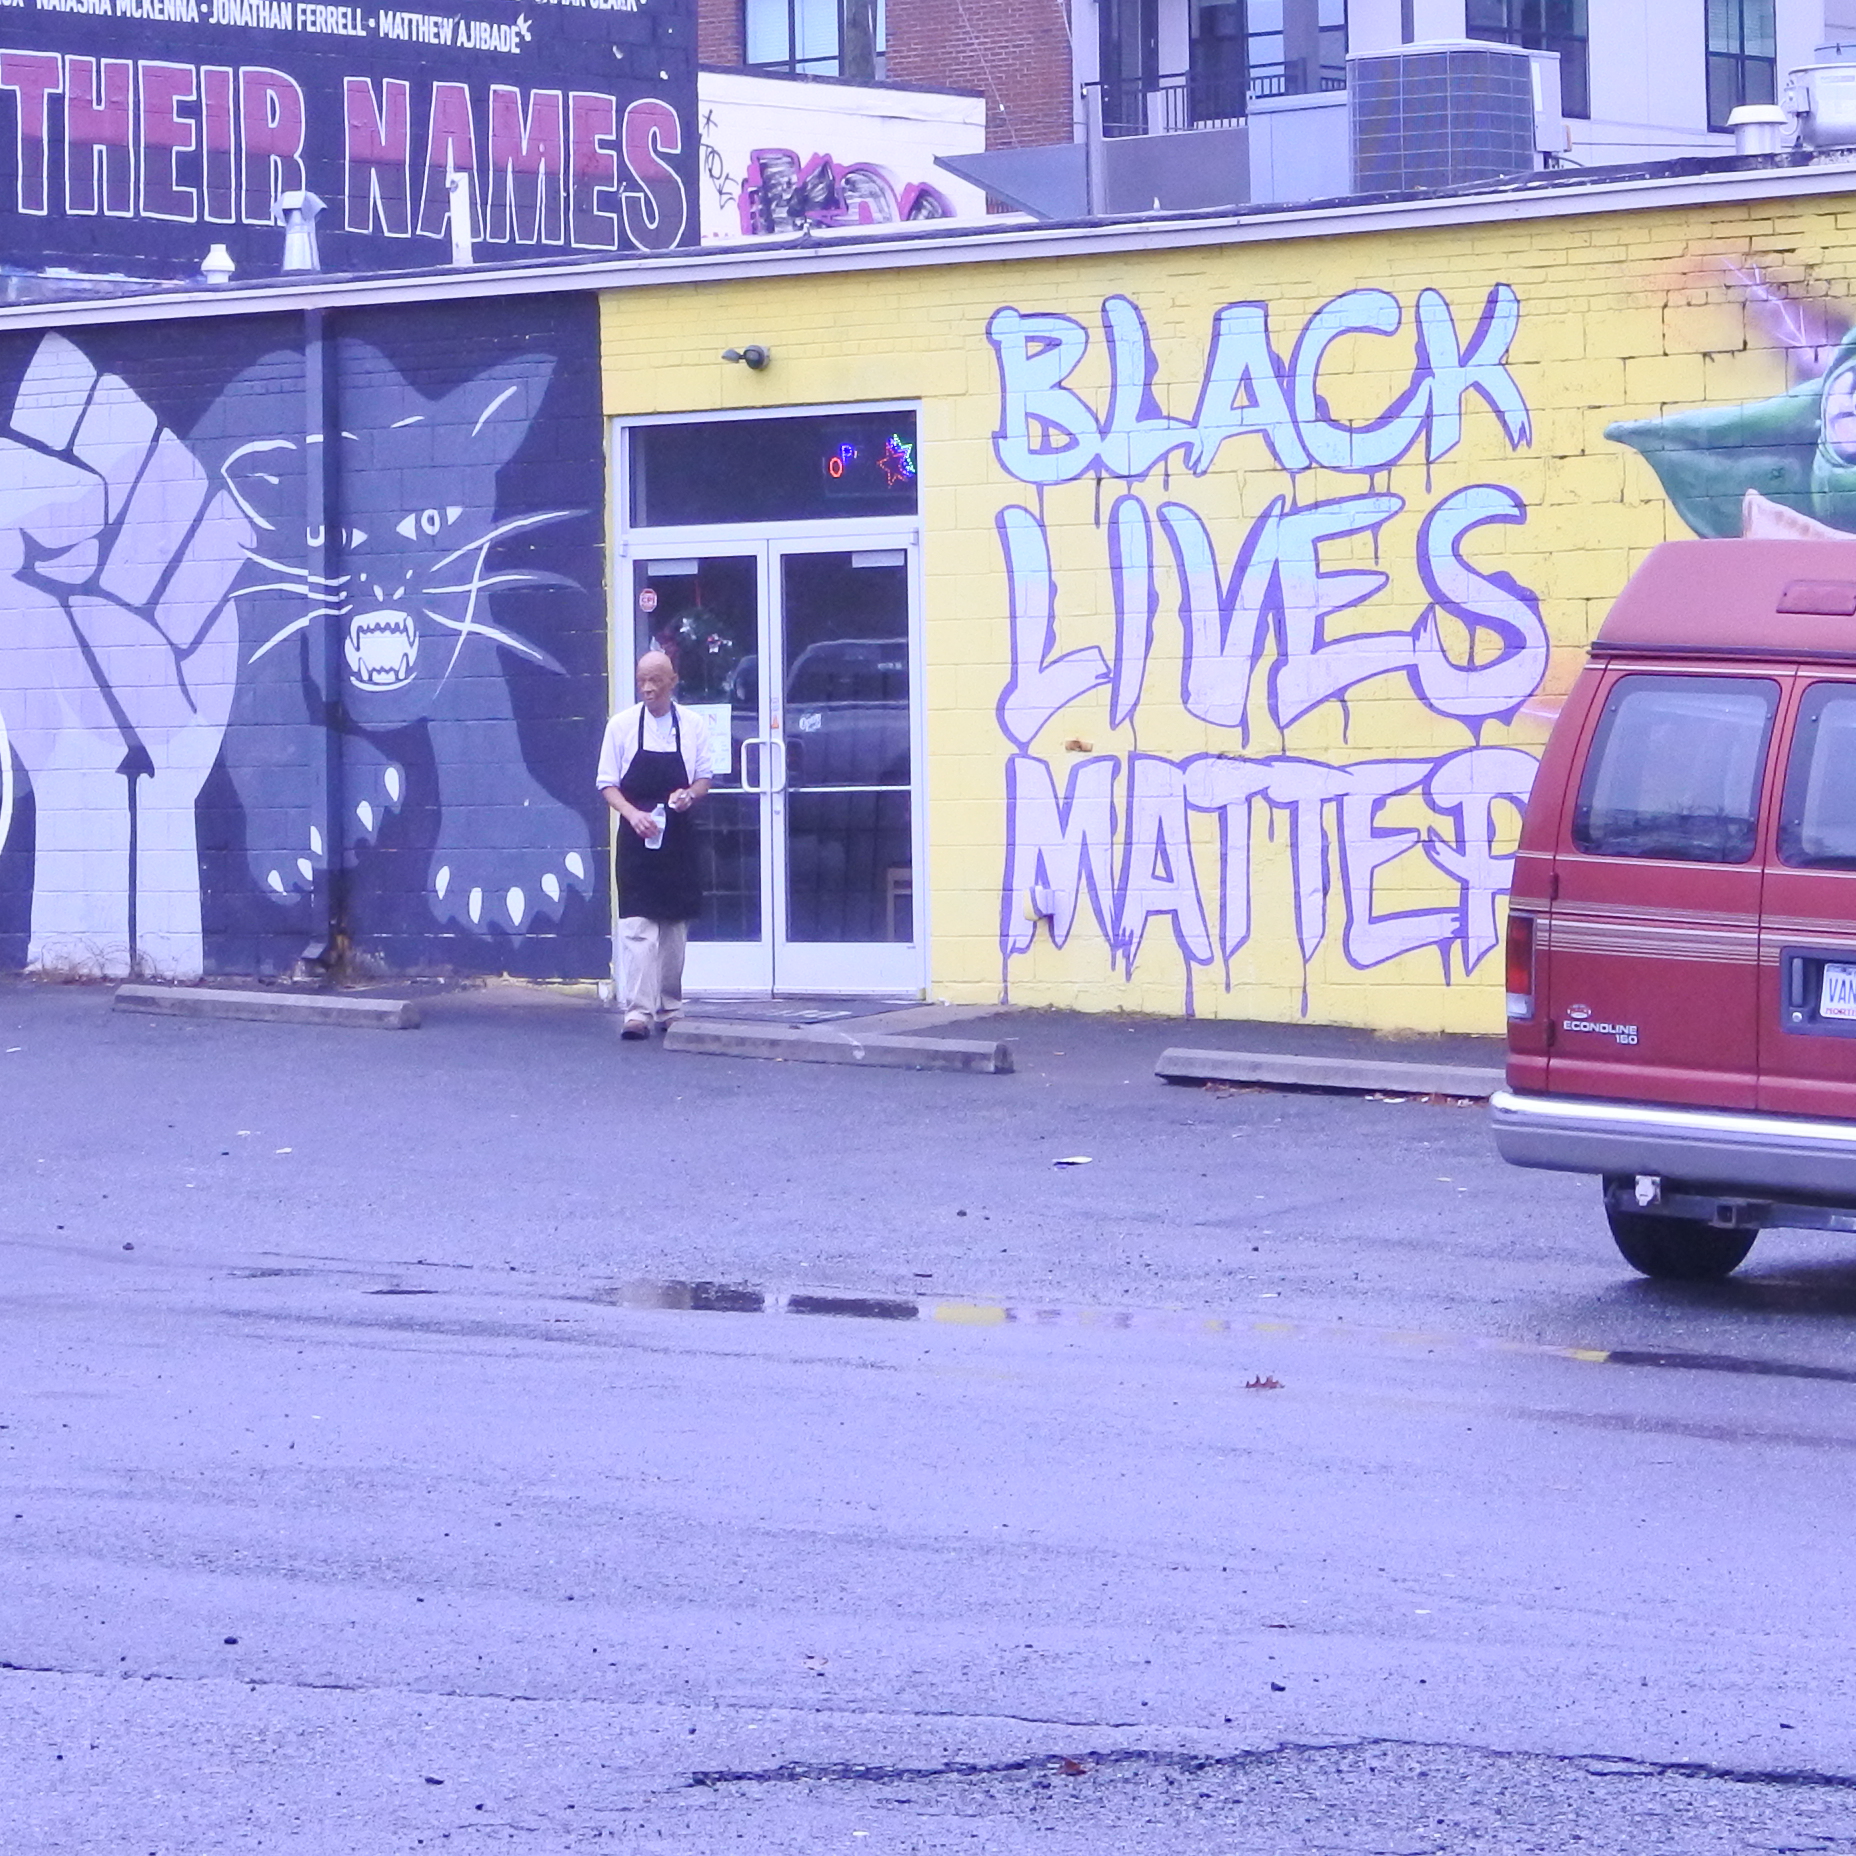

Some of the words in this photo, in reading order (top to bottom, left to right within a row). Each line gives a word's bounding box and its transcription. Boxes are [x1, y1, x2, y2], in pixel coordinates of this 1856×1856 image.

[297, 3, 367, 36] FERRELL
[379, 10, 453, 45] MATTHEW
[457, 20, 520, 54] AJIBADE
[344, 75, 689, 252] NAMES
[985, 282, 1535, 486] BLACK
[996, 483, 1550, 744] LIVES
[1563, 1020, 1638, 1036] ECONOLINE
